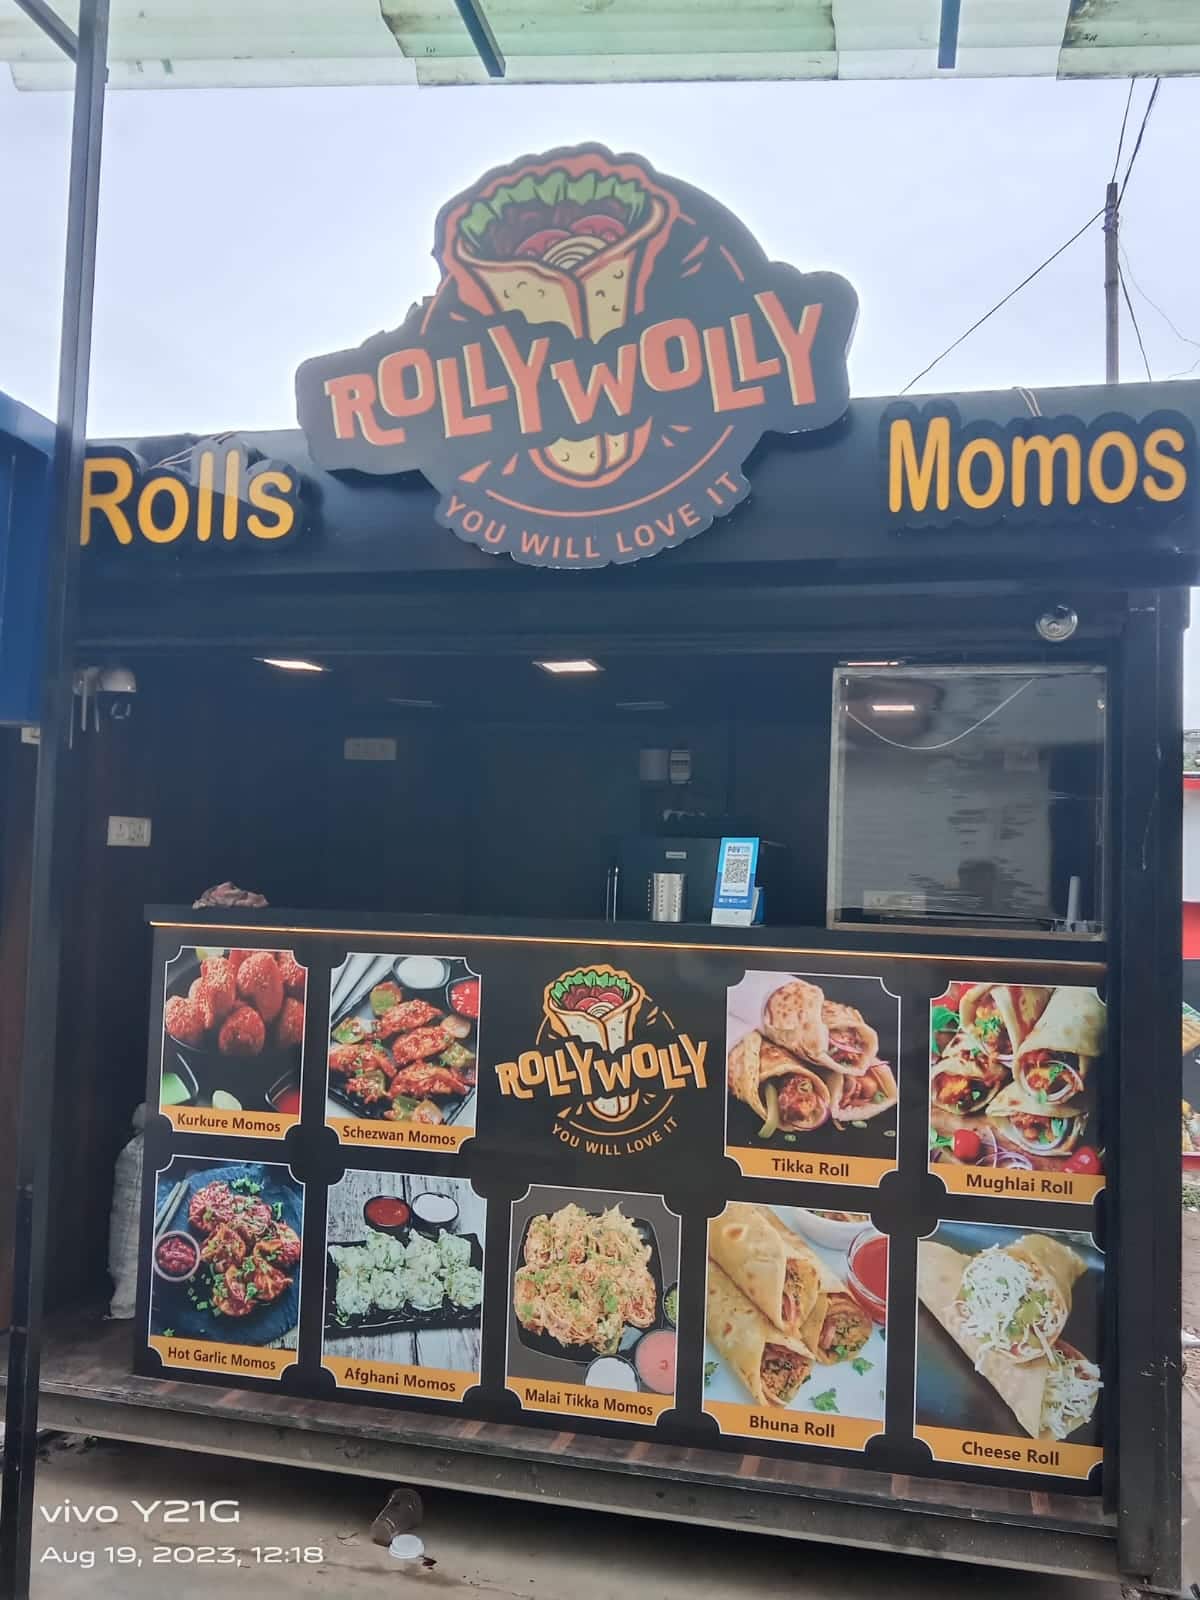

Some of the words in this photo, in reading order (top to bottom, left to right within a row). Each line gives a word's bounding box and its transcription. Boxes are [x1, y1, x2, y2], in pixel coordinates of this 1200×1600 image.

[888, 416, 1187, 513] Momos
[79, 449, 295, 546] Rolls
[443, 496, 503, 544] YOU
[520, 530, 600, 560] WILL
[615, 506, 700, 553] LOVE
[706, 471, 738, 506] IT
[177, 1112, 229, 1129] Kurkure
[232, 1117, 281, 1132] Momos
[342, 1125, 404, 1143] Schezwan
[407, 1132, 456, 1146] Momos
[551, 1123, 580, 1147] YOU
[585, 1141, 622, 1156] WILL
[627, 1131, 663, 1153] LOVE
[663, 1116, 679, 1134] IT
[771, 1157, 814, 1175] Tikka
[819, 1160, 850, 1178] Roll
[966, 1174, 1036, 1194] Mughlai
[1040, 1180, 1074, 1196] Roll
[167, 1347, 190, 1361] Hot
[193, 1350, 228, 1366] Garlic
[230, 1356, 277, 1371] Momos
[344, 1367, 400, 1387] Afghani
[403, 1374, 456, 1393] Momos
[525, 1388, 561, 1405] Malai
[564, 1393, 599, 1410] Tikka
[603, 1398, 653, 1417] Momos
[749, 1415, 800, 1435] Bhuna
[805, 1421, 836, 1439] Roll
[962, 1441, 1022, 1462] Cheese
[1027, 1448, 1060, 1467] Roll
